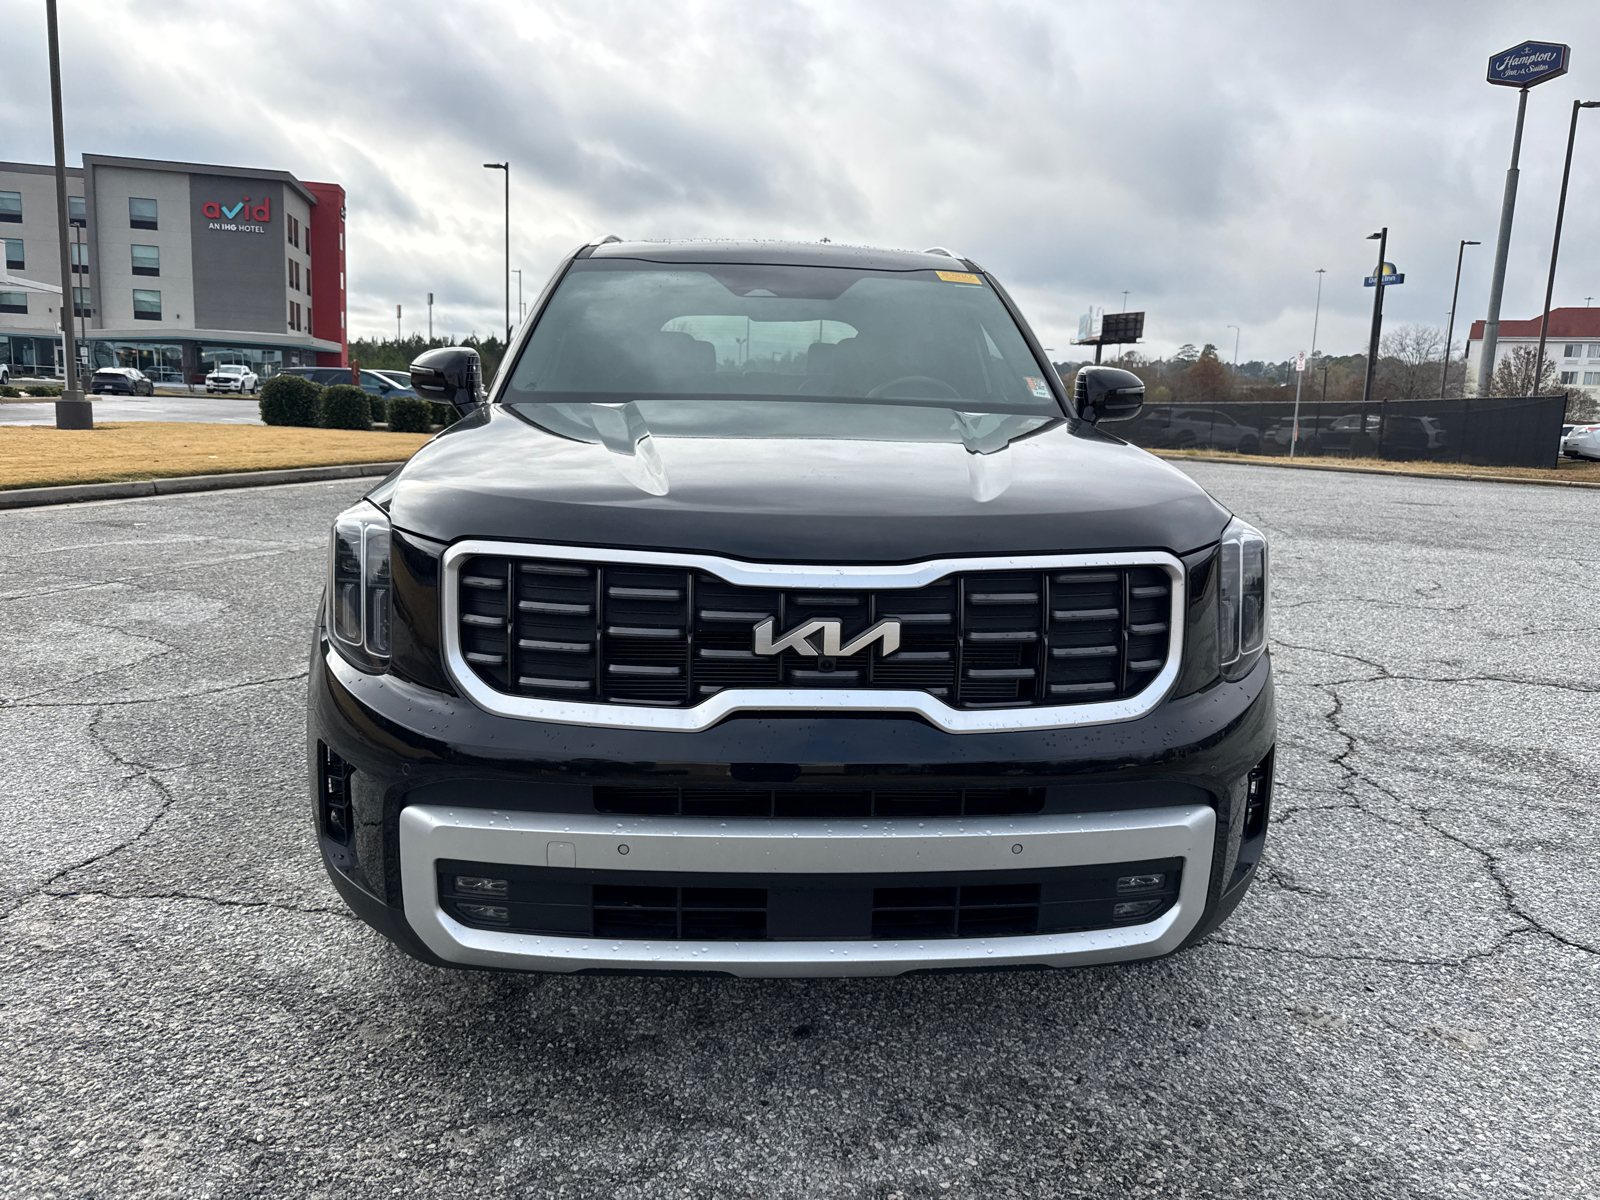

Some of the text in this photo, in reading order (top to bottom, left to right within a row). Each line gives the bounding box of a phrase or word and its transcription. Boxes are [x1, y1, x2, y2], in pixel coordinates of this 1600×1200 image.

[1495, 52, 1556, 71] Hampton
[1501, 69, 1520, 78] Inn
[1526, 64, 1549, 73] Suites
[202, 195, 270, 222] avid
[208, 222, 265, 234] AN IHG HOTEL
[753, 616, 901, 657] KIA
